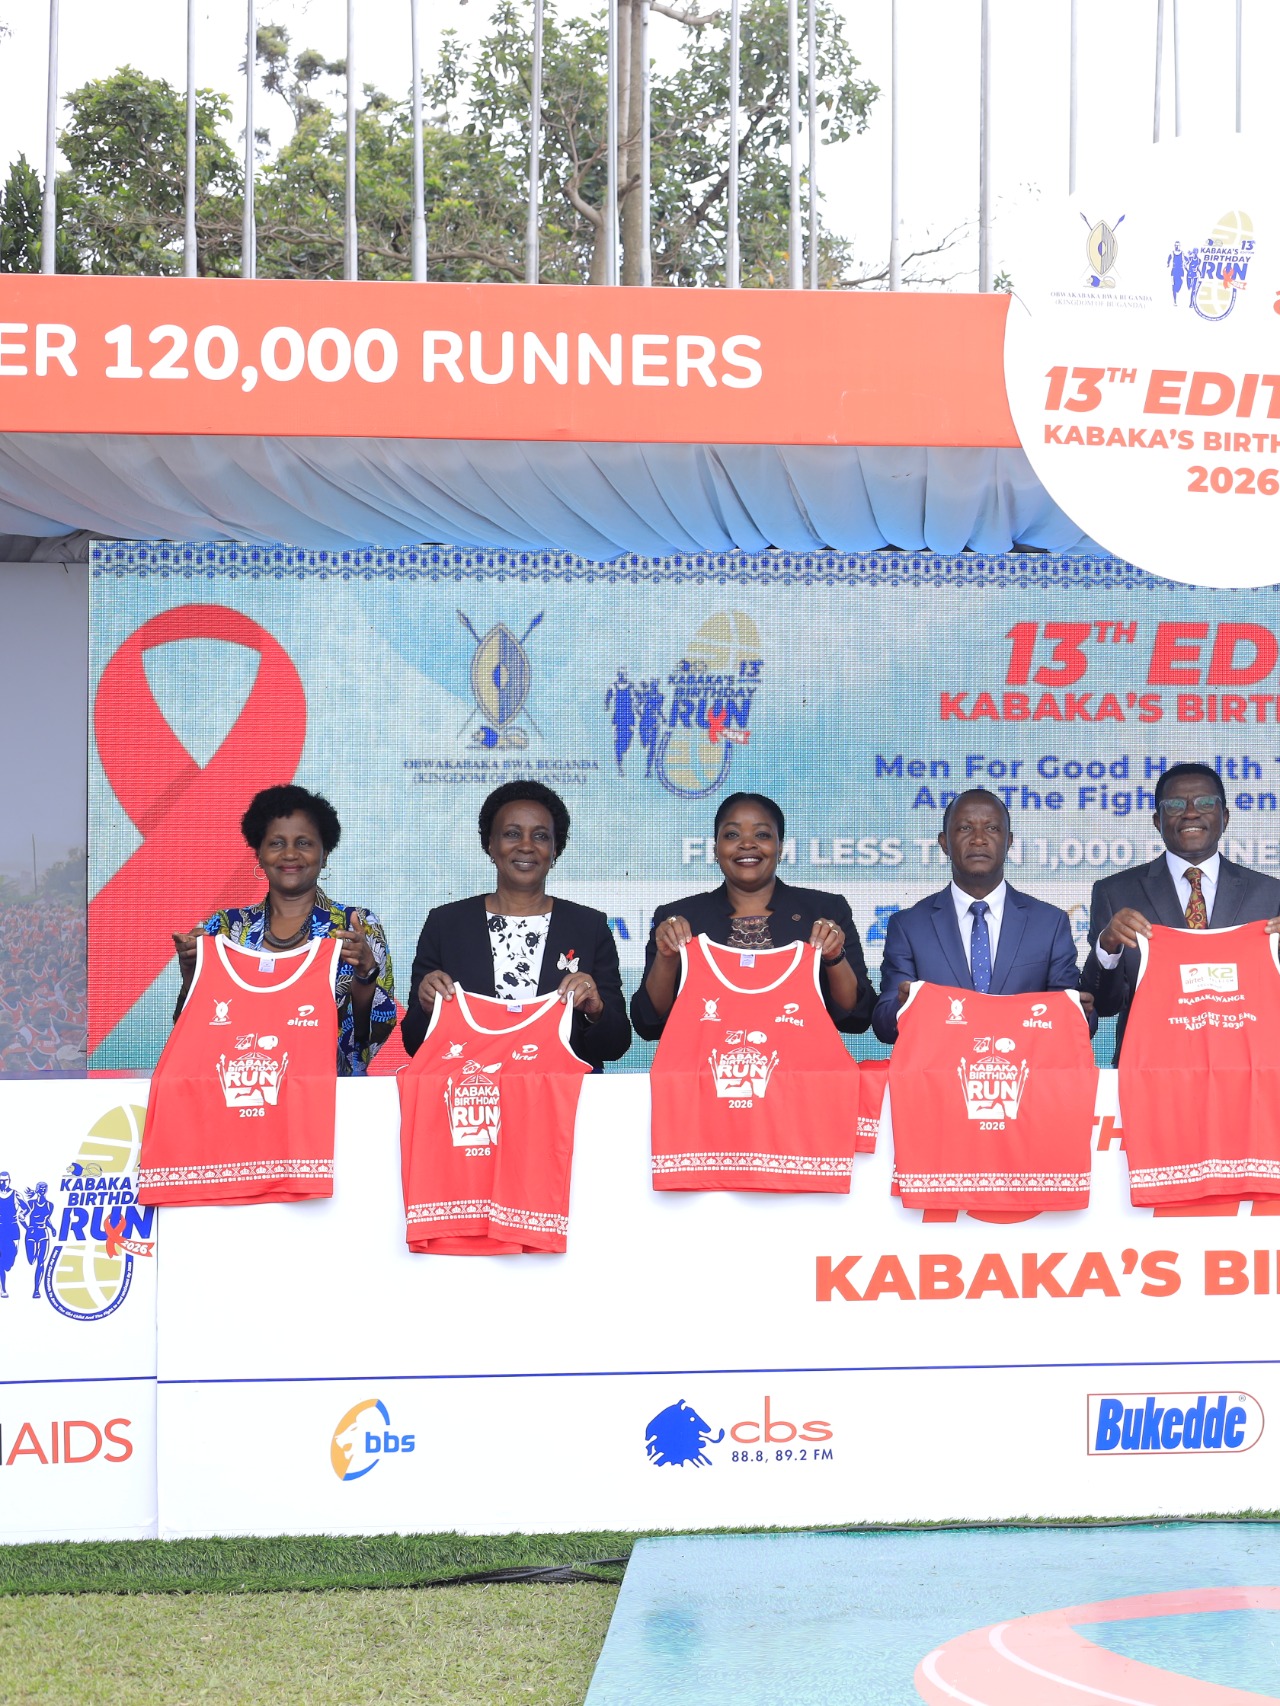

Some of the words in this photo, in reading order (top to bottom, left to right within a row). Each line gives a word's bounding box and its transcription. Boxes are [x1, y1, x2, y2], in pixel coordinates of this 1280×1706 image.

[1200, 247, 1239, 255] KABAKA'S
[1203, 255, 1251, 263] BIRTHDAY
[1200, 262, 1248, 280] RUN
[104, 324, 399, 393] 120,000
[422, 330, 763, 389] RUNNERS
[1043, 365, 1137, 413] 13TH
[1043, 424, 1195, 451] KABAKA'S
[1187, 465, 1280, 496] 2026
[1004, 620, 1138, 688] 13TH
[669, 699, 751, 728] RUN
[939, 691, 1164, 722] KABAKA'S
[875, 755, 950, 778] Men
[966, 755, 1023, 778] For
[1037, 754, 1129, 779] Good
[1144, 755, 1262, 779] Hlth
[913, 784, 983, 809] An
[998, 785, 1063, 809] The
[1079, 784, 1155, 815] Figh
[810, 837, 904, 866] LESS
[1032, 839, 1132, 869] 1,000
[1185, 976, 1204, 985] airtel
[1207, 966, 1233, 979] K2
[287, 1018, 319, 1027] airtel
[775, 1015, 805, 1027] airtel
[1022, 1019, 1053, 1029] airtel
[1168, 1016, 1189, 1025] THE
[1191, 1012, 1220, 1023] FIGHT
[1222, 1014, 1237, 1022] TO
[1238, 1011, 1257, 1021] END
[1185, 1019, 1206, 1031] AIDS
[1209, 1018, 1220, 1028] BY
[718, 1064, 767, 1078] RUN
[969, 1063, 1018, 1072] KABAKA
[969, 1071, 1018, 1080] BIRTHDAY
[225, 1071, 277, 1087] RUN
[454, 1086, 500, 1097] KABAKA
[968, 1080, 1017, 1100] RUN
[454, 1096, 500, 1106] BIRTHDAY
[728, 1100, 753, 1109] 2026
[239, 1108, 265, 1118] 2026
[453, 1106, 499, 1126] RUN
[979, 1121, 1005, 1131] 2026
[465, 1148, 491, 1157] 2026
[60, 1177, 139, 1192] KABAKA
[68, 1191, 139, 1206] BIRTHD
[59, 1206, 155, 1241] RUN
[121, 1240, 148, 1255] 2026
[816, 1248, 1182, 1302] KABAKA'S
[730, 1396, 833, 1444] cbs
[1095, 1395, 1247, 1451] Bukedde
[0, 1418, 133, 1466] AIDS
[365, 1431, 416, 1453] bbs
[731, 1451, 769, 1463] 88.8,
[775, 1450, 807, 1461] 89.2
[813, 1449, 833, 1460] FM
